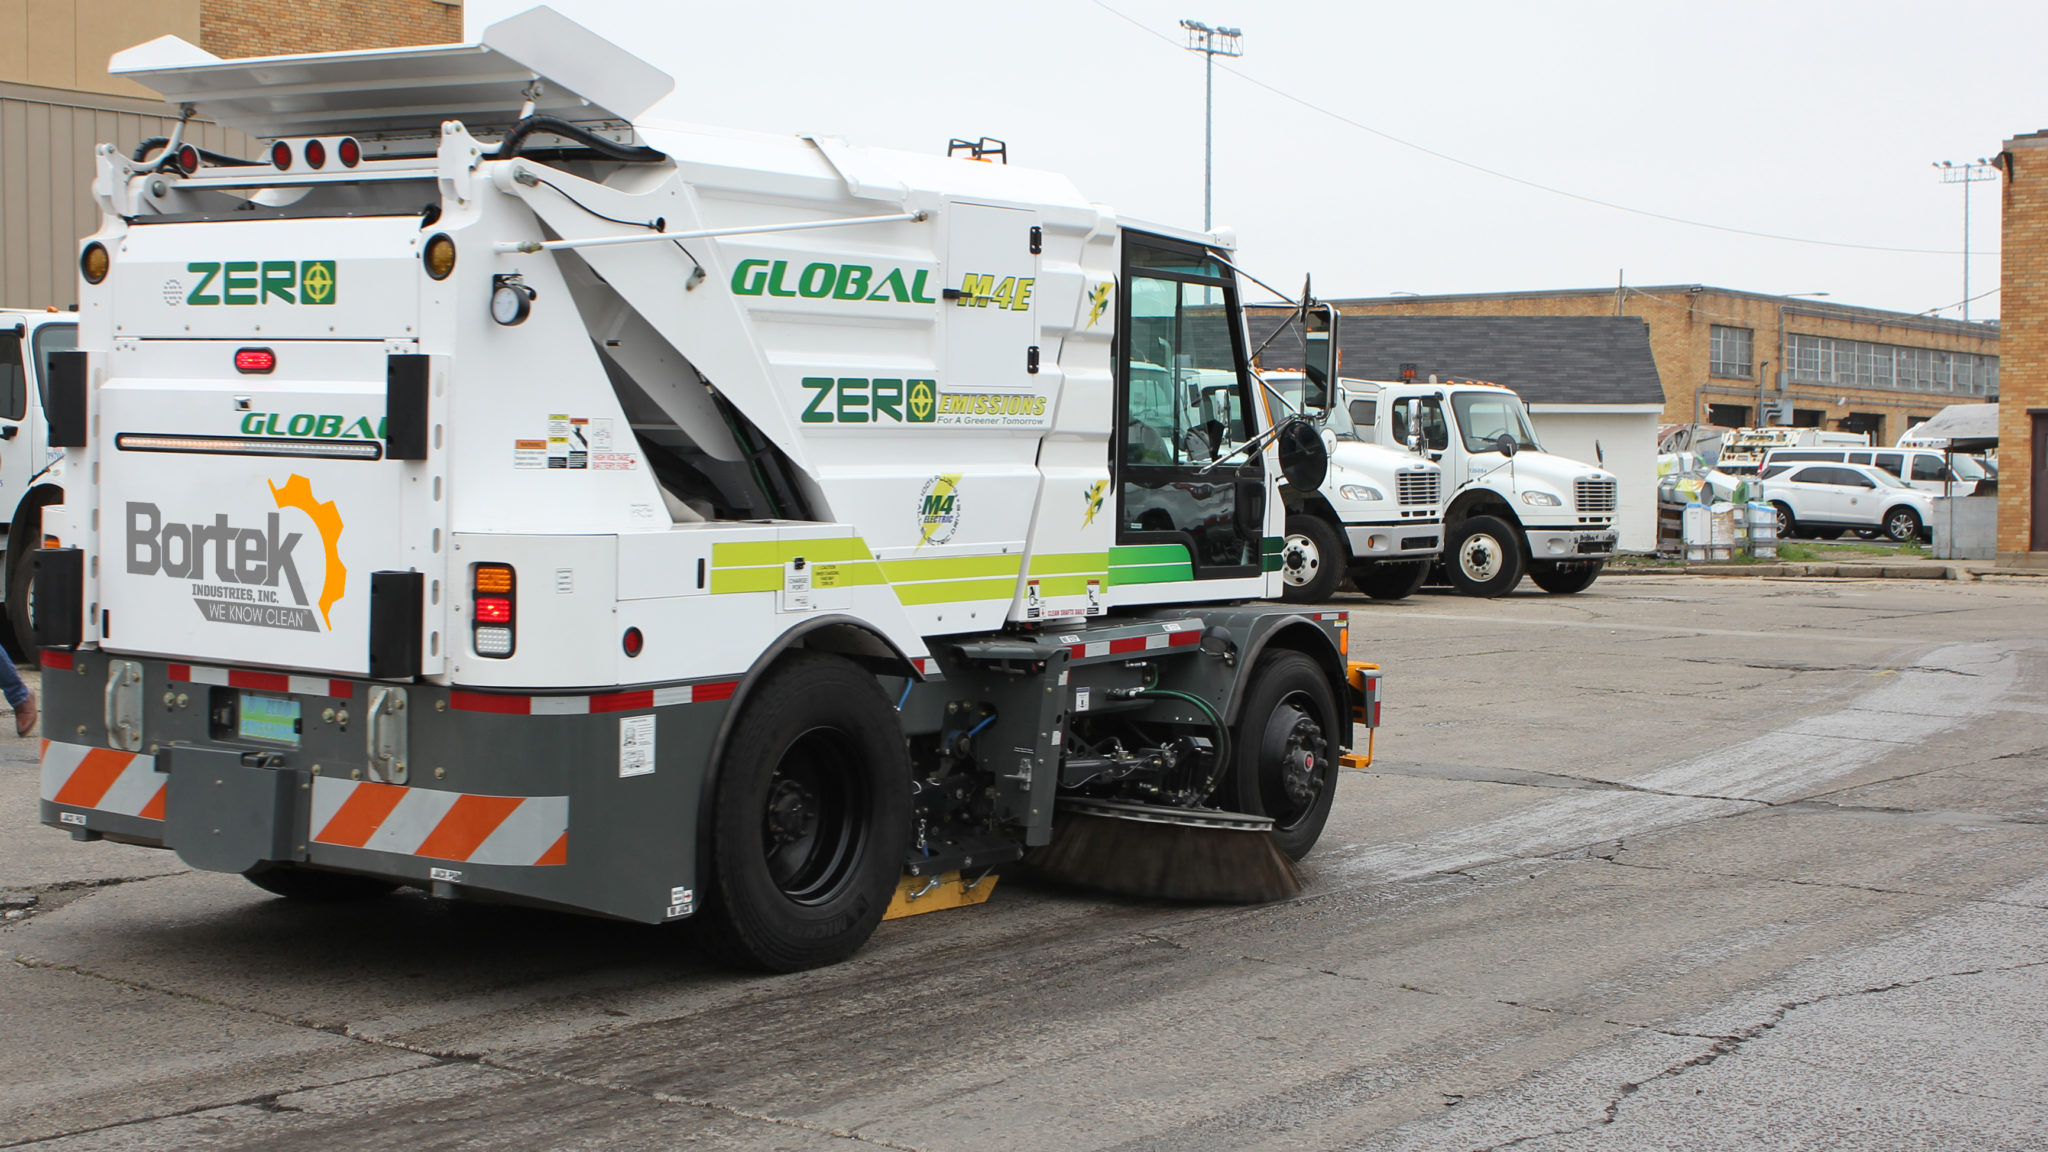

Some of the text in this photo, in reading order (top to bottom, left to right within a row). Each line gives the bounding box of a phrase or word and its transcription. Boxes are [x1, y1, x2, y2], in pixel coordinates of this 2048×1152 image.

[187, 260, 336, 305] ZERO
[731, 258, 1035, 311] GLOBAL M4E
[801, 377, 1047, 423] ZERO EMISSIONS
[937, 416, 1044, 425] For A Greener Tomorrow
[921, 495, 955, 515] M4
[923, 515, 954, 523] ELECTRIC
[126, 501, 309, 606] Bortek
[192, 583, 280, 603] INDUSTRIES, INC.
[209, 603, 304, 628] WE KNOW CLEAN
[1047, 609, 1059, 617] CLEAN
